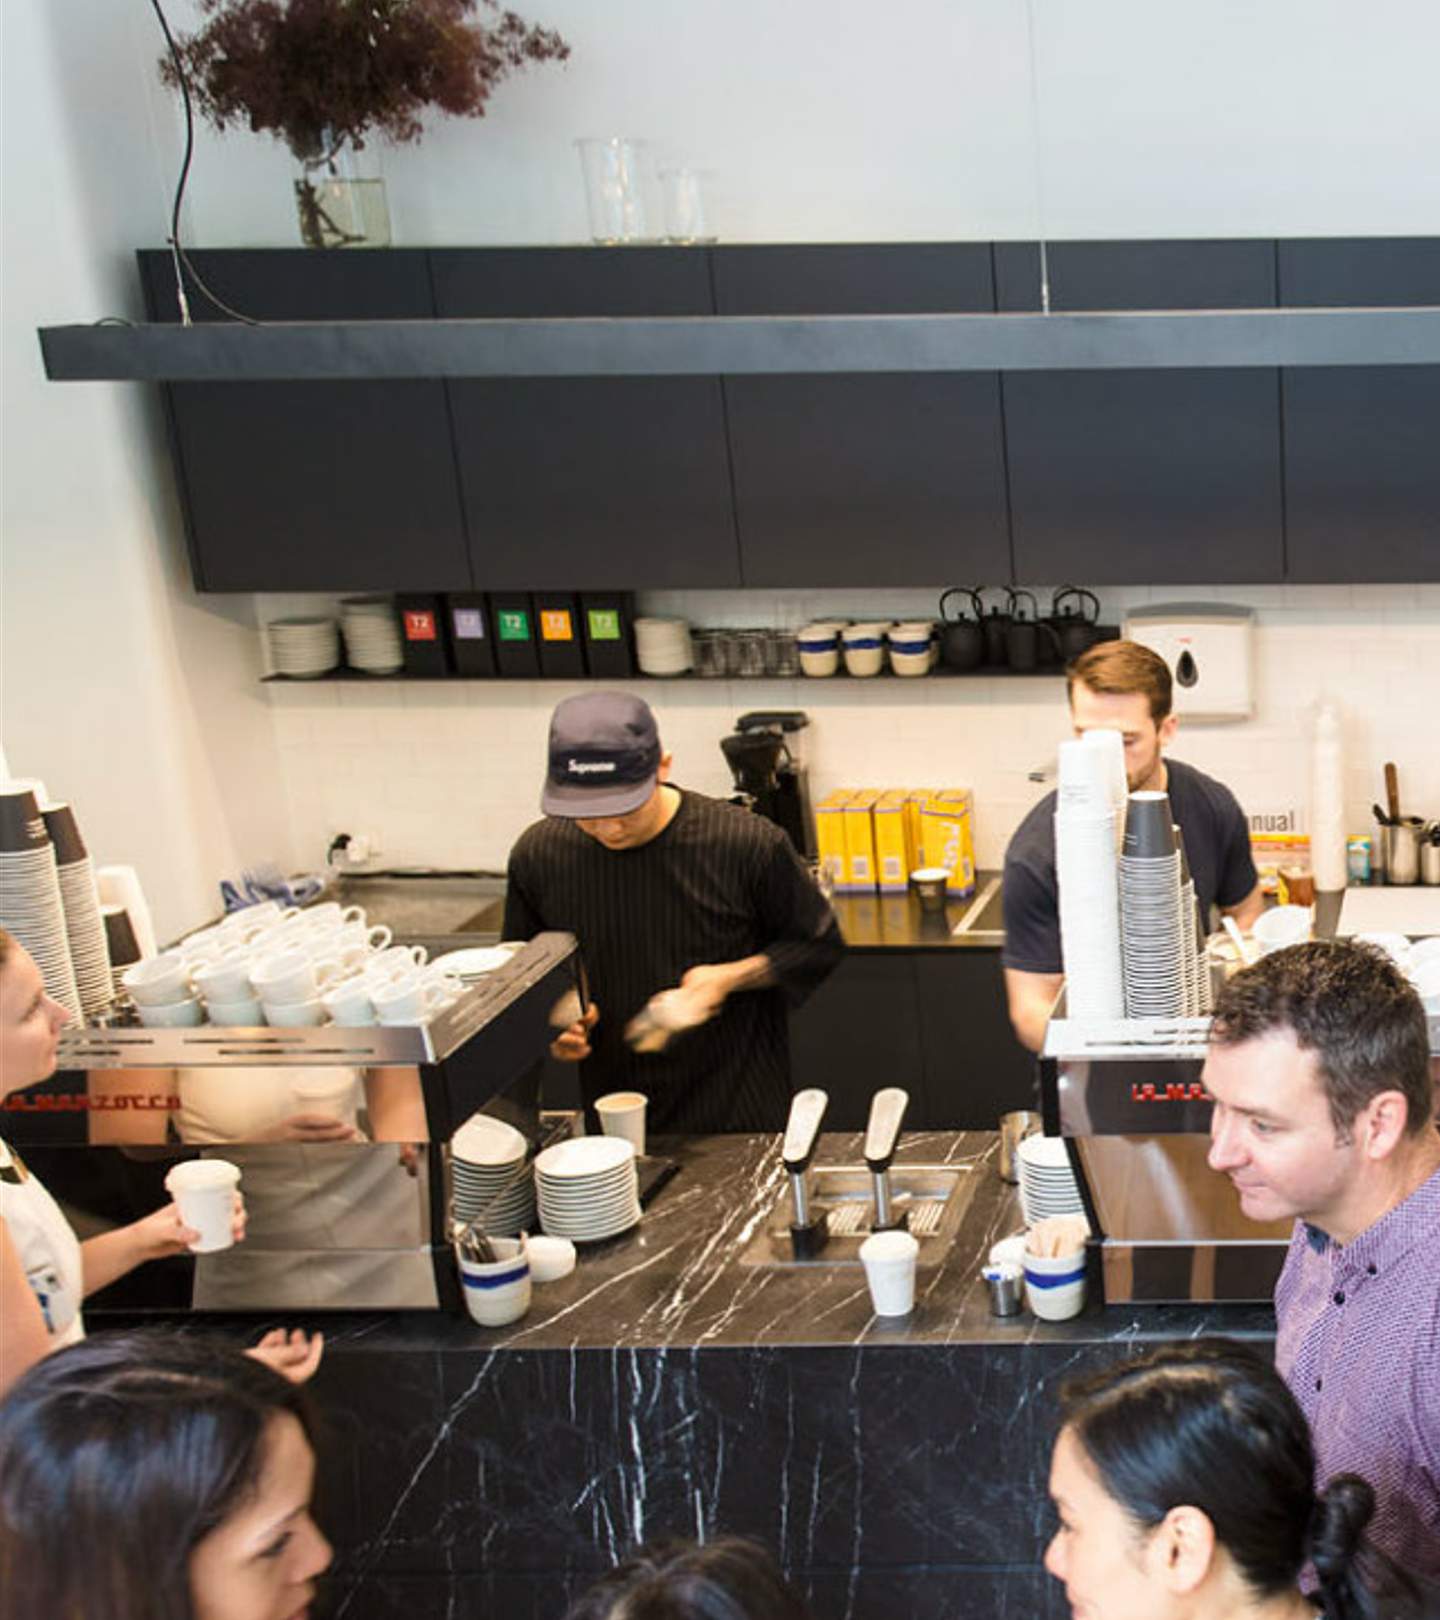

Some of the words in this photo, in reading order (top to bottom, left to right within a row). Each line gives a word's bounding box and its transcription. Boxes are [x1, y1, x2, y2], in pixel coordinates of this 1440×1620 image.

[411, 616, 429, 629] T2
[504, 615, 521, 629] T2
[1251, 810, 1295, 832] nual
